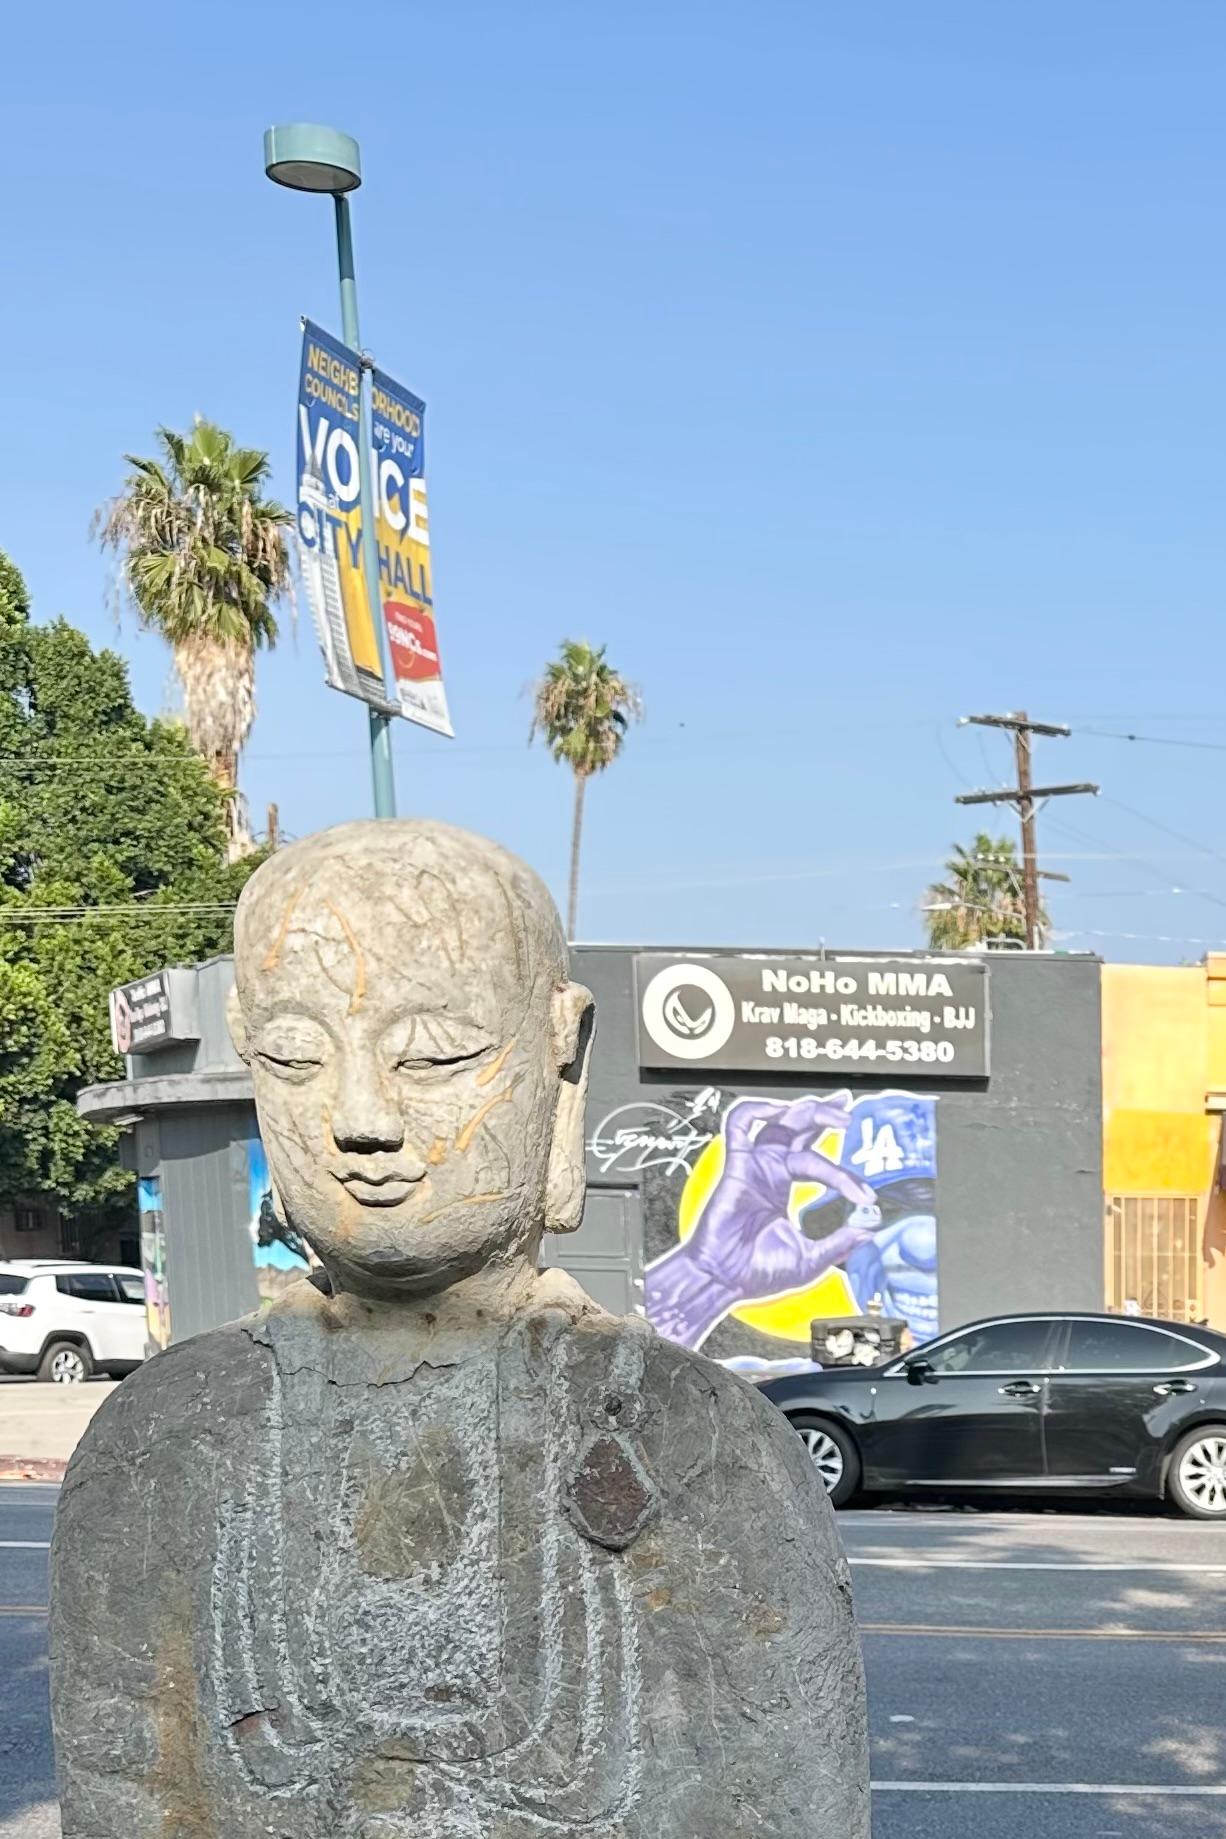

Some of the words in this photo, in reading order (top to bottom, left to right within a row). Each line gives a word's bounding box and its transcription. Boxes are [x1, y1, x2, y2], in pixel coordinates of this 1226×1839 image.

[374, 421, 391, 444] are
[391, 432, 415, 458] your
[298, 501, 363, 570] CITY
[377, 539, 432, 606] HALL
[761, 969, 858, 994] NoHo
[867, 972, 953, 997] MMA
[741, 1001, 780, 1024] Krav
[783, 1002, 828, 1031] Maga
[840, 1003, 931, 1033] Kickboxing
[943, 1006, 976, 1029] BJJ
[765, 1036, 955, 1063] 818-644-5380
